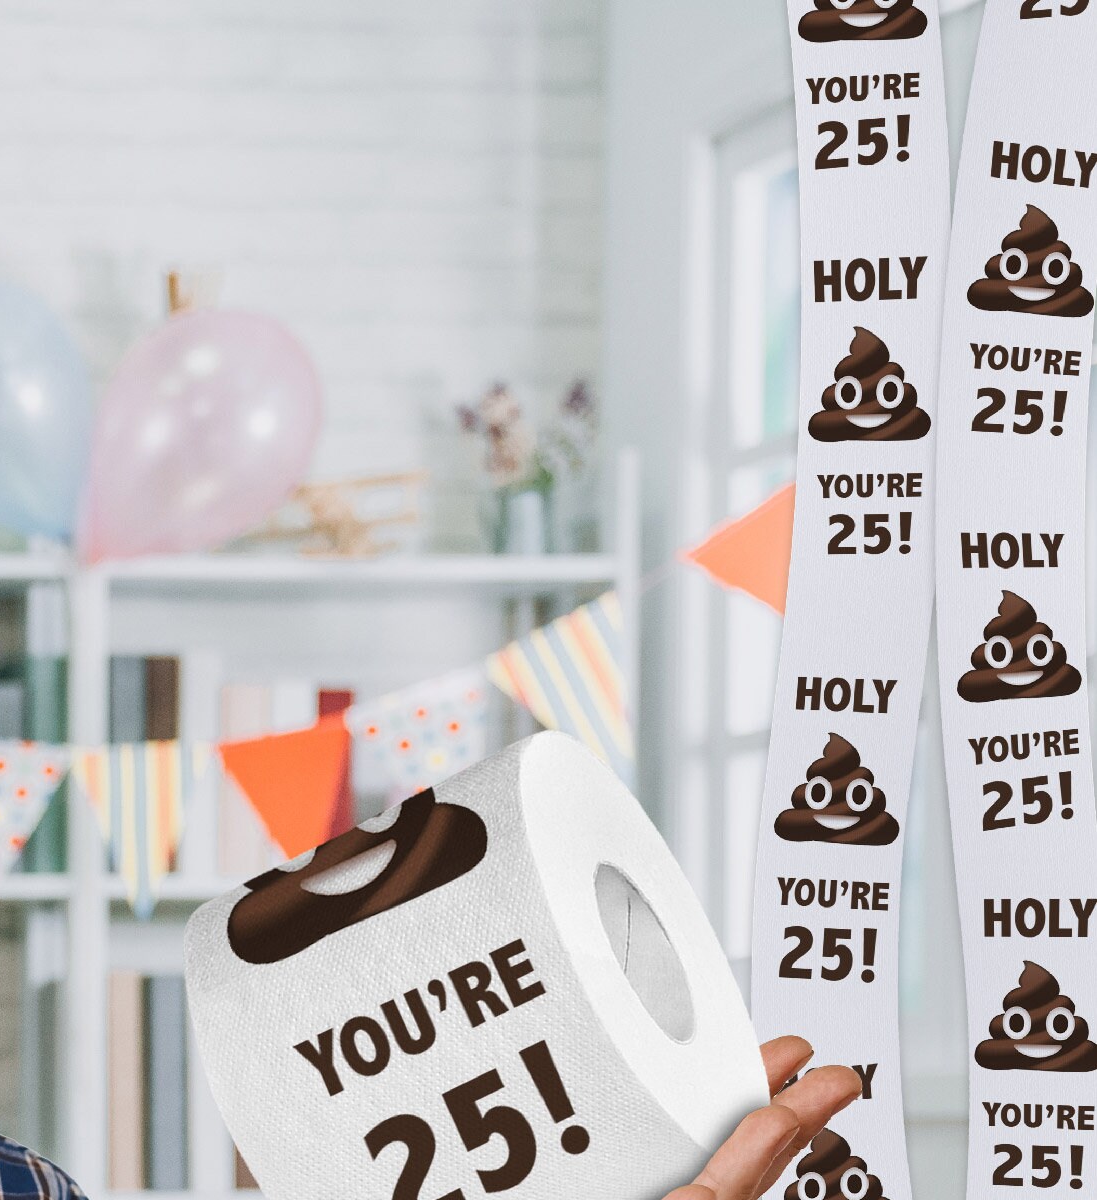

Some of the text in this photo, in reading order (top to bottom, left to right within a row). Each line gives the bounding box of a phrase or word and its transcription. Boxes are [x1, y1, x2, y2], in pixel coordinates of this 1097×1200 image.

[806, 73, 919, 104] YOU'RE
[815, 115, 910, 170] 25!
[991, 141, 1097, 188] HOLY
[814, 256, 927, 302] HOLY
[970, 343, 1081, 376] YOU'RE
[971, 388, 1067, 436] 25!
[817, 473, 922, 498] YOU'RE
[828, 512, 912, 554] 25!
[961, 533, 1064, 569] HOLY
[796, 677, 897, 713] HOLY
[968, 729, 1079, 765] YOU'RE
[983, 771, 1073, 831] 25!
[778, 877, 889, 911] YOU'RE
[984, 898, 1097, 937] HOLY
[779, 926, 877, 983] 25!
[293, 938, 545, 1096] YOU'RE
[982, 1102, 1095, 1130] YOU'RE
[993, 1144, 1083, 1189] 25!
